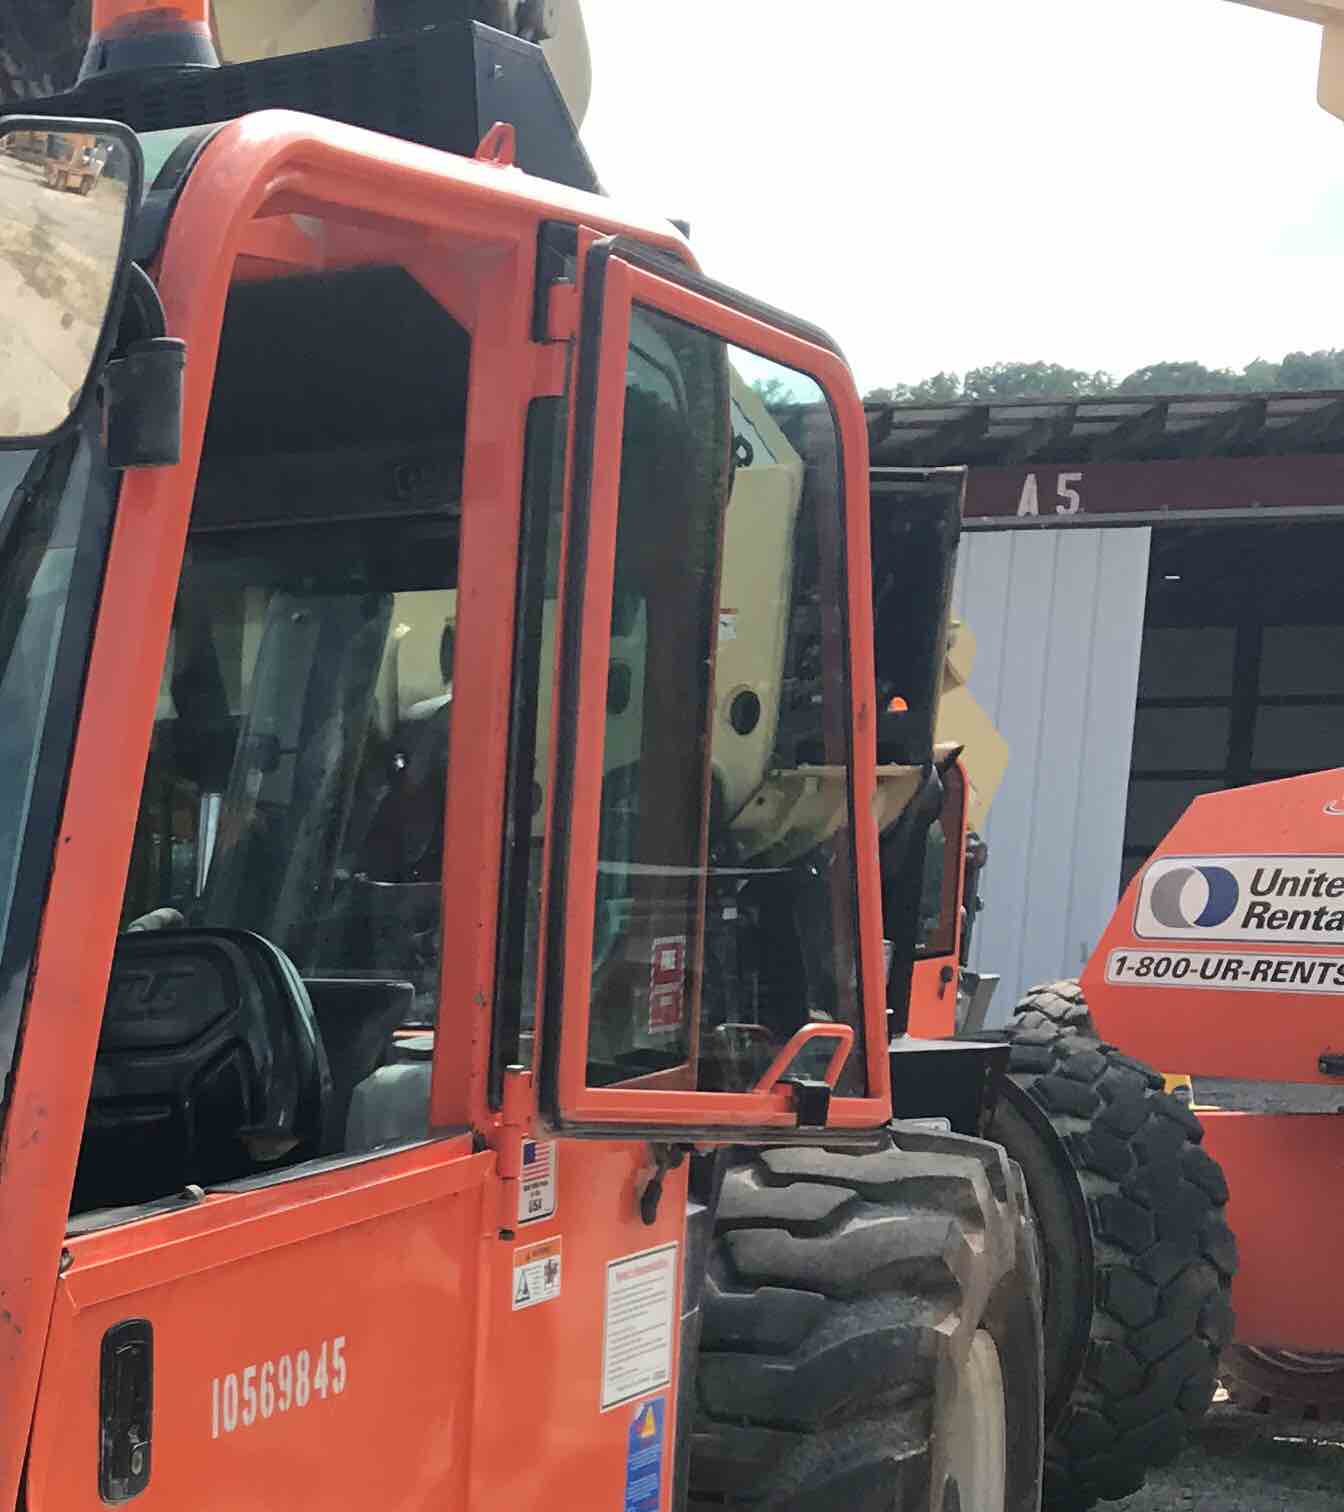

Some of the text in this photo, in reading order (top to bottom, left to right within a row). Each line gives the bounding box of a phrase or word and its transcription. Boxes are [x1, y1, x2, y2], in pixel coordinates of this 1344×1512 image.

[1016, 471, 1083, 517] A 5
[211, 1334, 347, 1441] 10569845
